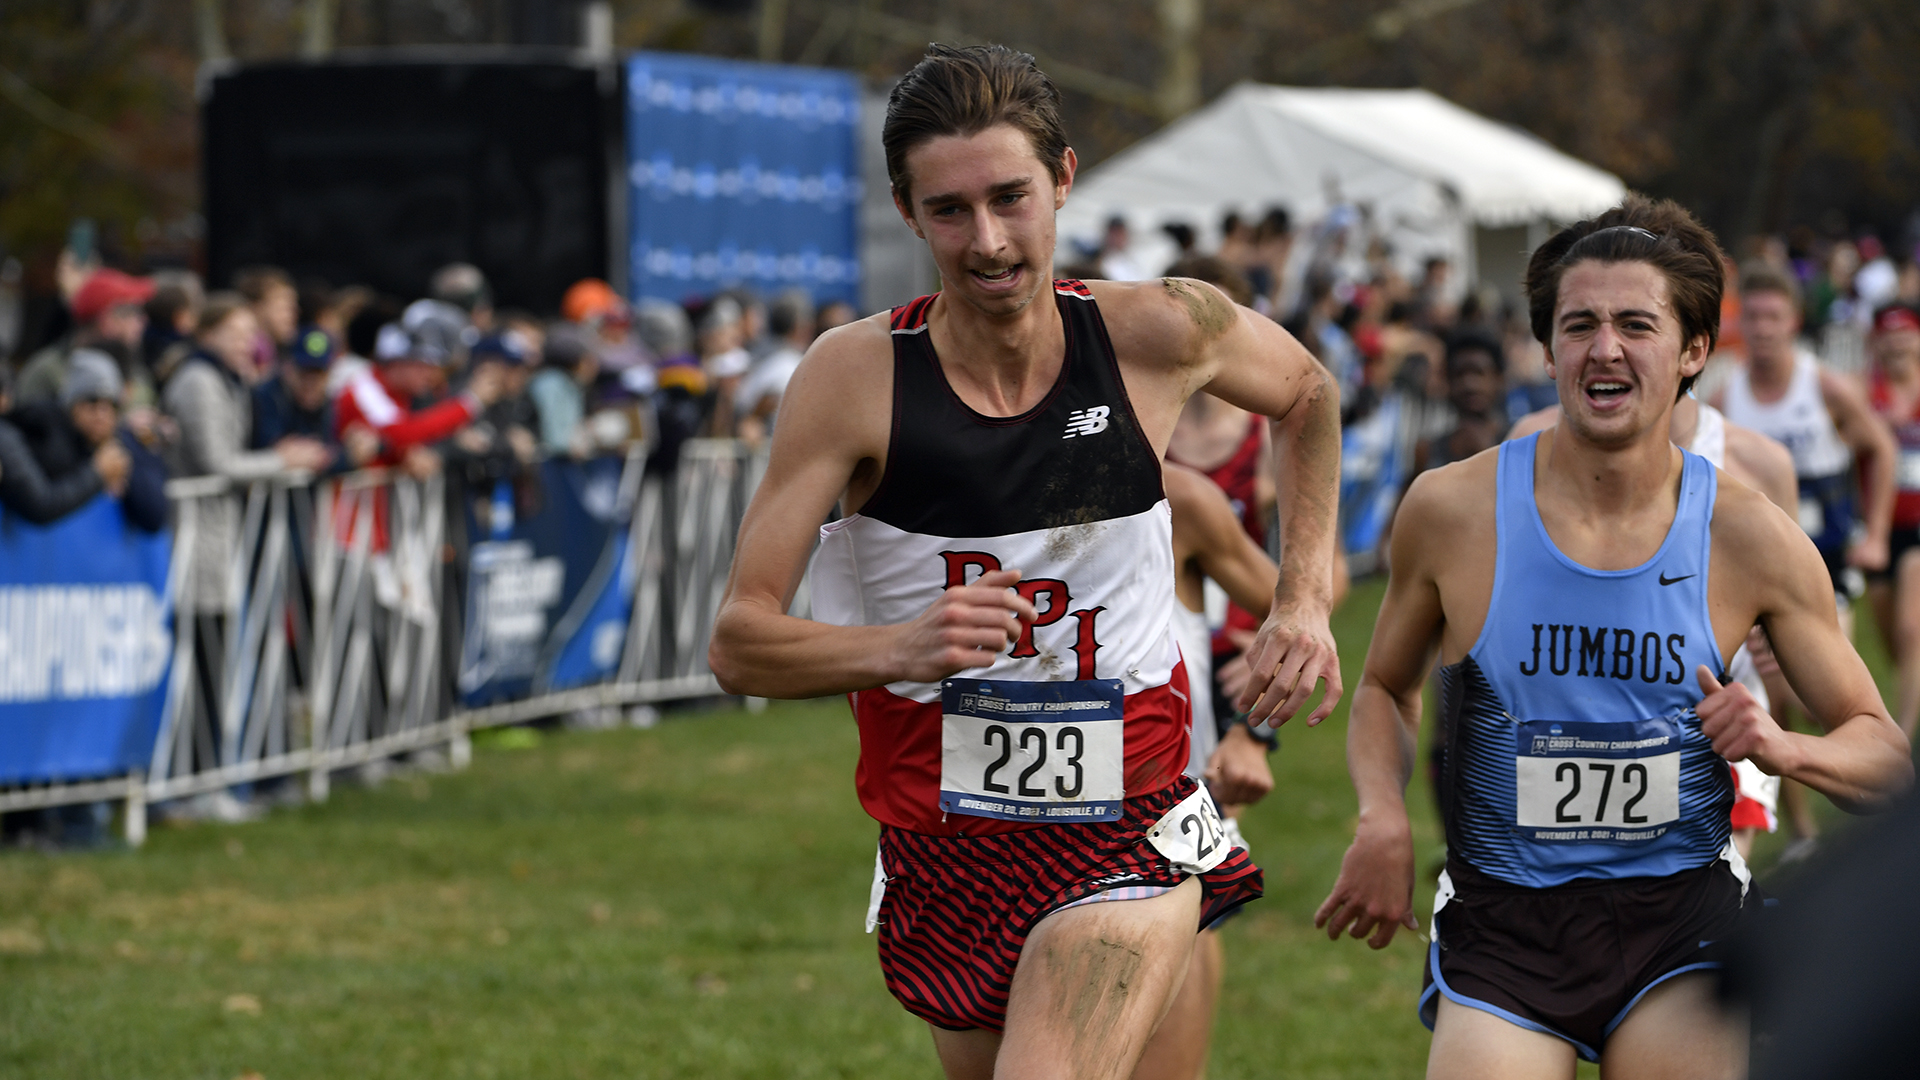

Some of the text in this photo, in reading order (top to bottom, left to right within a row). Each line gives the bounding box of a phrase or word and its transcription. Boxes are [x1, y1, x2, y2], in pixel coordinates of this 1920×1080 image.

[1061, 404, 1111, 440] NB
[1519, 623, 1686, 685] JUMBOS
[977, 698, 1005, 711] CROSS
[1004, 702, 1044, 712] COUNTRY
[1043, 700, 1111, 712] CHAMPIONSHIPS
[1548, 736, 1670, 750] CROSS COUNTRY CHAMPIONSHIPS
[983, 724, 1084, 798] 223
[1555, 762, 1648, 824] 272
[957, 798, 1004, 814] NOVEMBER
[1003, 804, 1018, 816] 20,
[1045, 806, 1093, 817] LOUISVILLE,
[1093, 806, 1107, 816] KY
[1534, 830, 1577, 840] NOVEMBER
[1591, 830, 1610, 839] 2021
